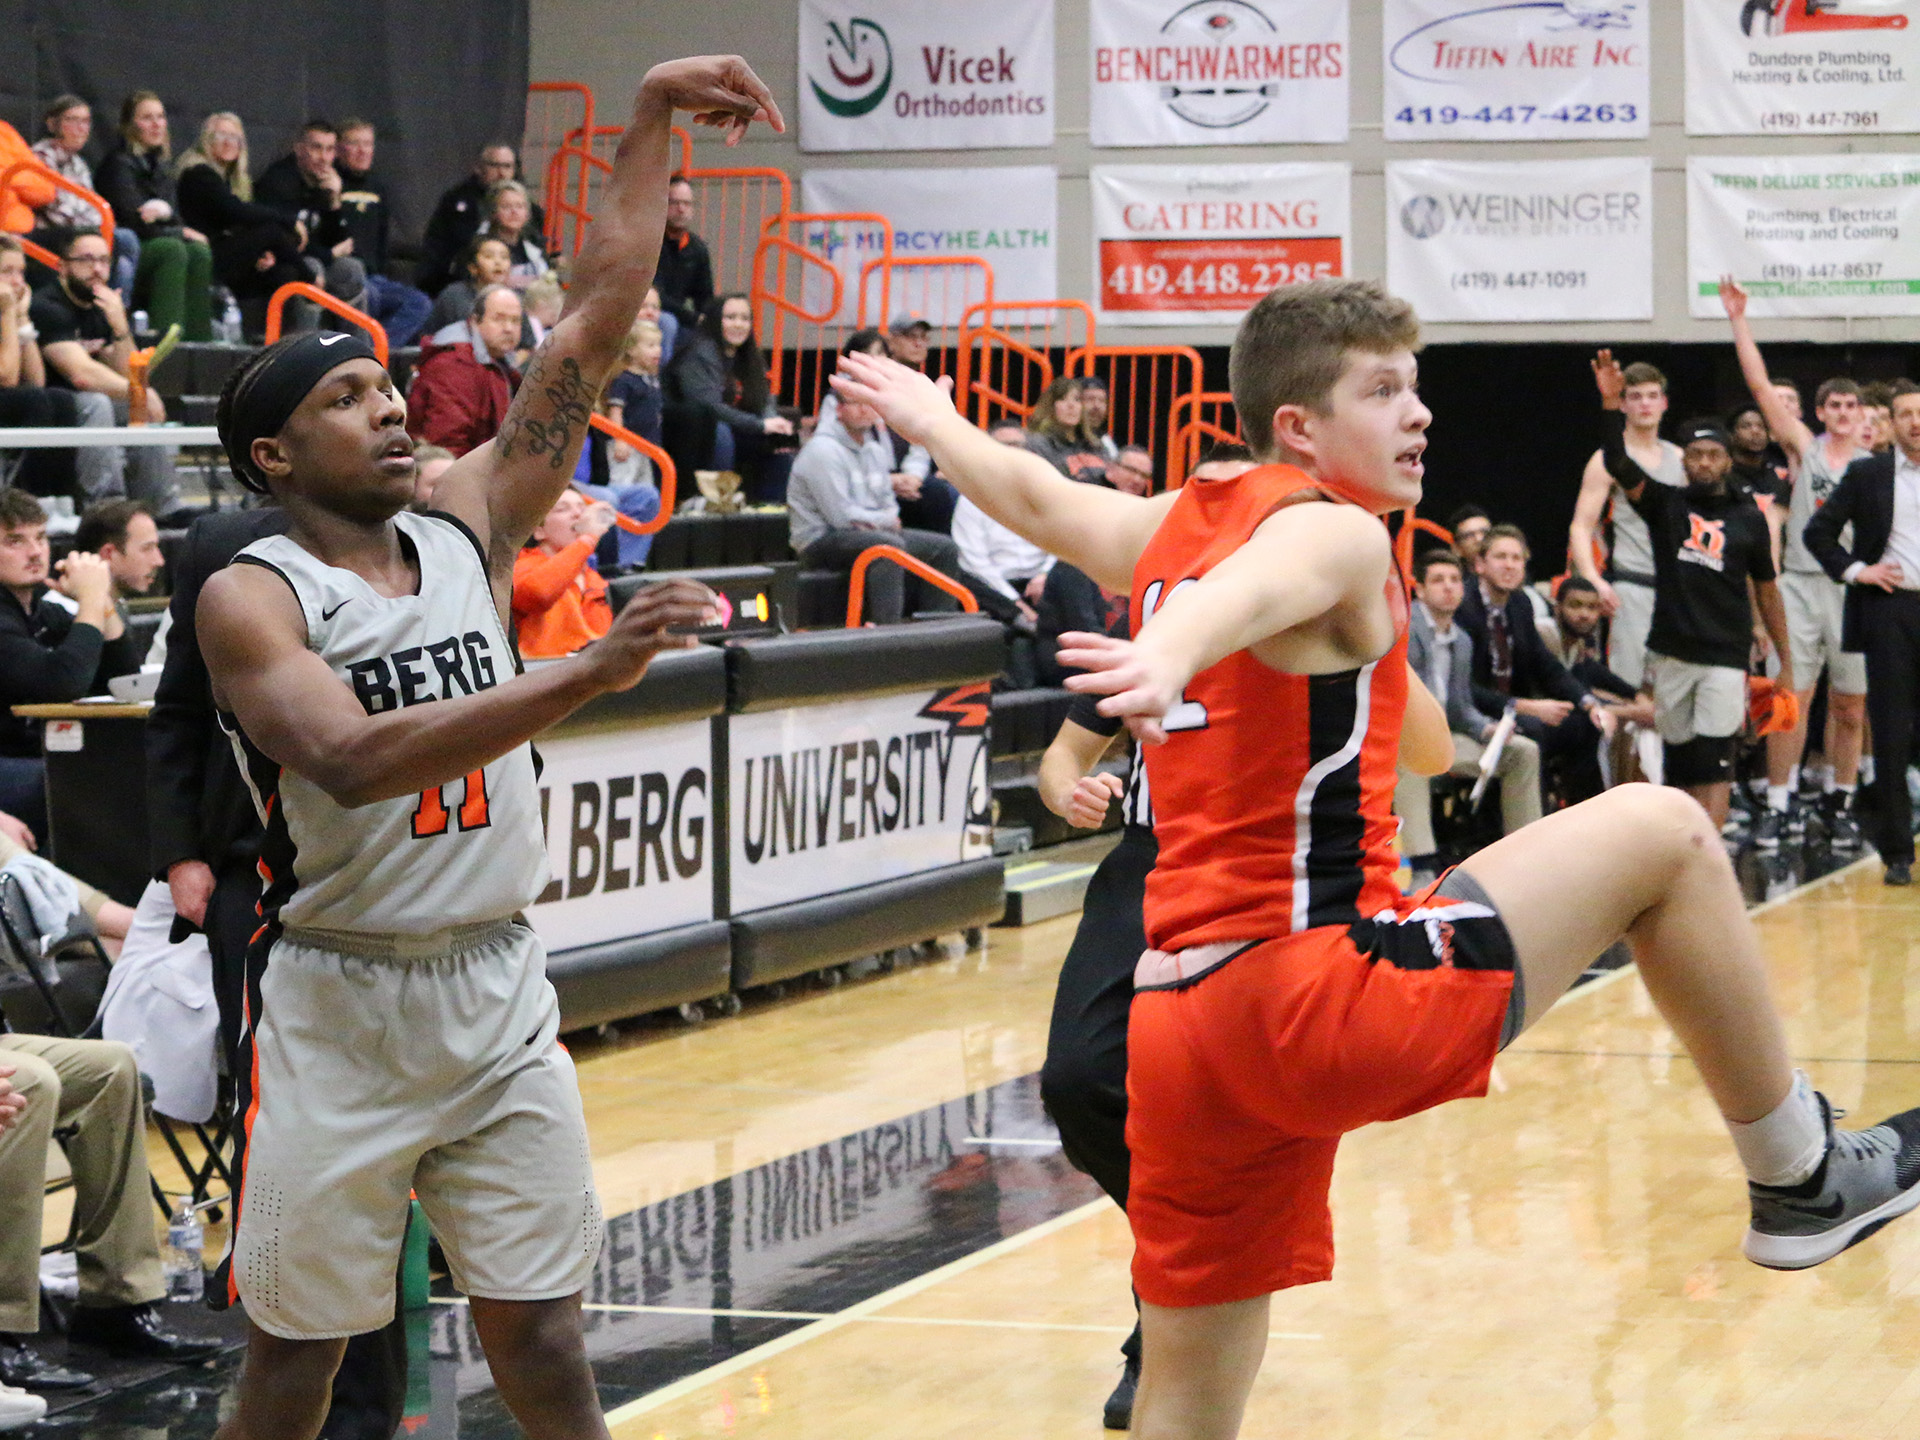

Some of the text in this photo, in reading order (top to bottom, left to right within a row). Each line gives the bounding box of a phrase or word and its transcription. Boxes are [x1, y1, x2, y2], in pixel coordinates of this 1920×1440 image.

[922, 46, 1015, 84] Vicek
[1096, 43, 1343, 83] BENCHWARMERS
[1433, 40, 1506, 69] TIFFIN
[1518, 40, 1579, 68] AIRE
[1749, 51, 1891, 67] Dundore Plumbing
[1732, 68, 1791, 84] Heating
[1797, 70, 1808, 83] &
[895, 91, 1045, 118] Orthodontics
[1395, 104, 1638, 125] 419-447-4263
[1761, 111, 1879, 129] (419) 447-7961
[1762, 174, 1820, 189] DELUXE
[1825, 173, 1898, 189] SERVICES
[1122, 201, 1319, 232] CATERING
[1448, 192, 1641, 223] WEININGER
[1829, 207, 1897, 222] Electrical
[1745, 224, 1899, 242] Heating and Cooling
[1451, 271, 1587, 290] (419) 447-1091
[1762, 262, 1883, 280] (419) 447-8637
[345, 631, 497, 717] BERG
[743, 729, 955, 865] UNIVERSITY
